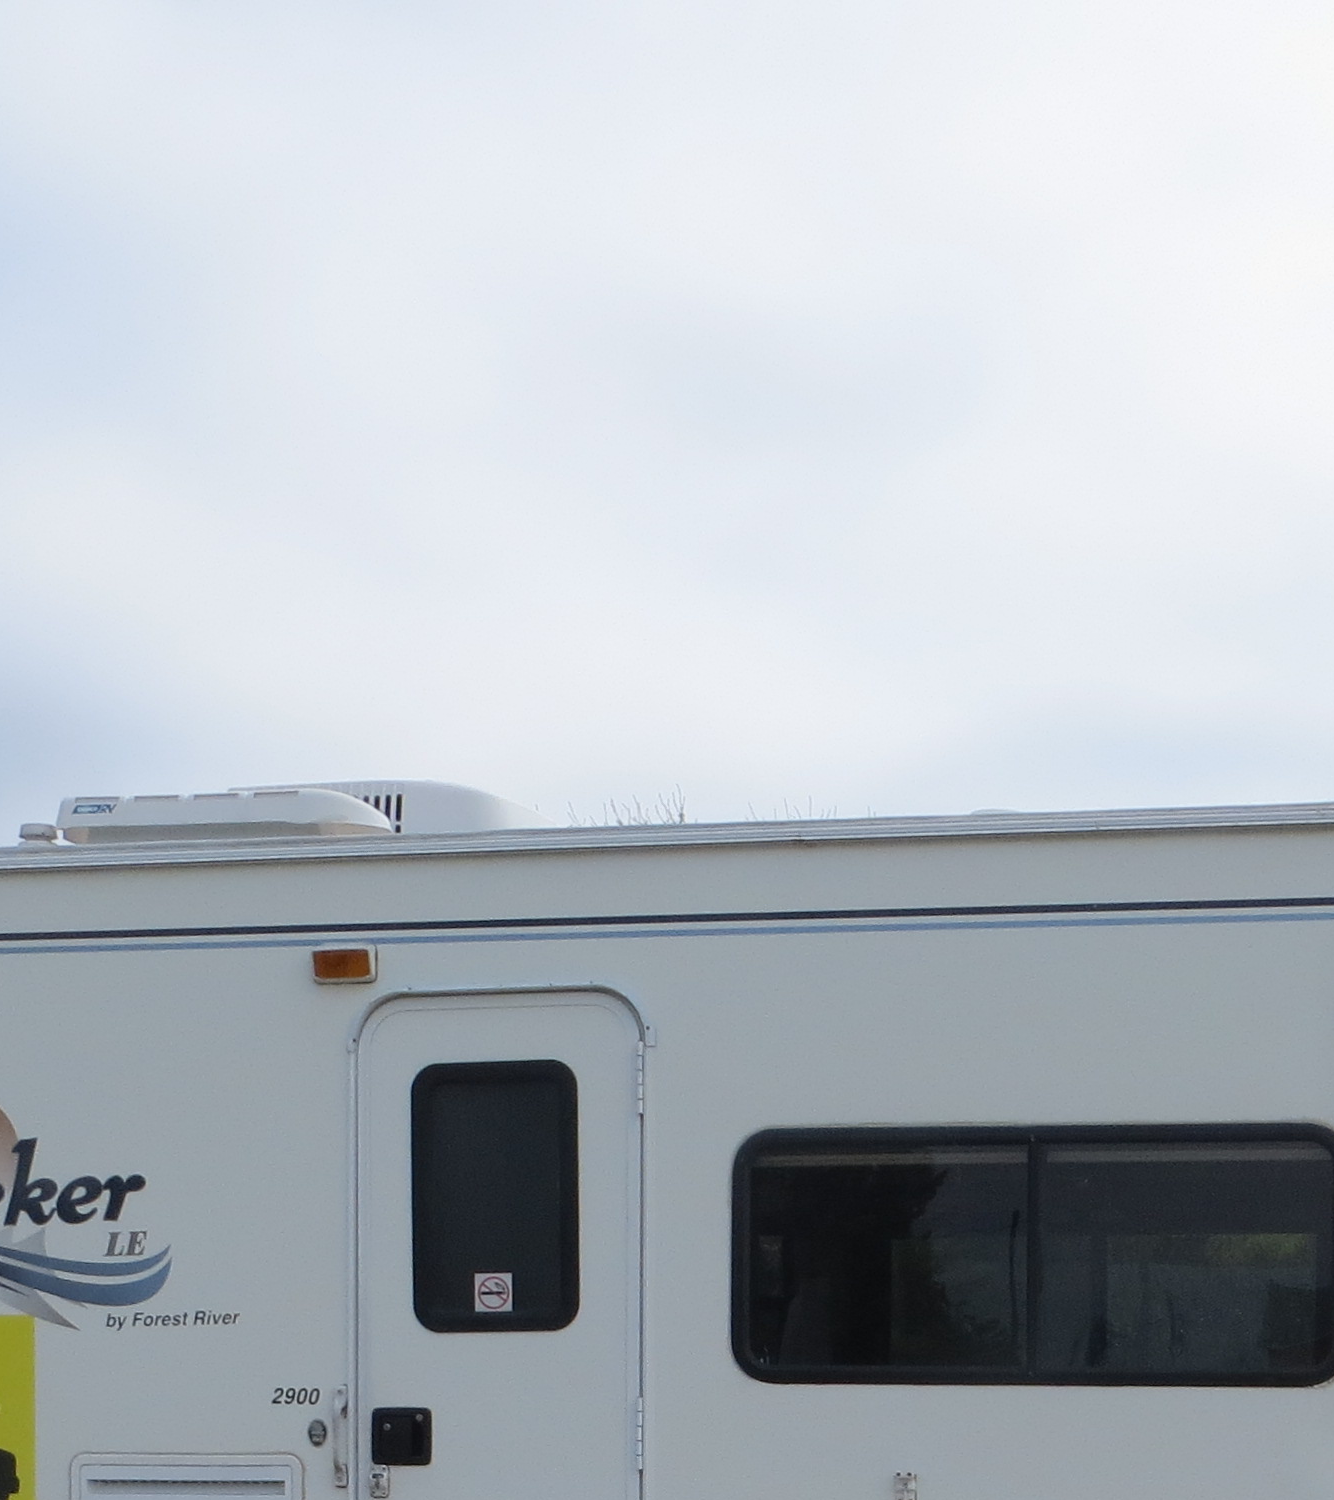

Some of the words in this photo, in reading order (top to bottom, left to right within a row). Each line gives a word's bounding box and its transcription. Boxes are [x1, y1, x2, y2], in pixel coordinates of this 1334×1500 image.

[103, 1230, 148, 1257] LE
[105, 1313, 127, 1331] by
[132, 1312, 188, 1327] Forest
[193, 1310, 240, 1326] River
[271, 1387, 321, 1405] 2900
